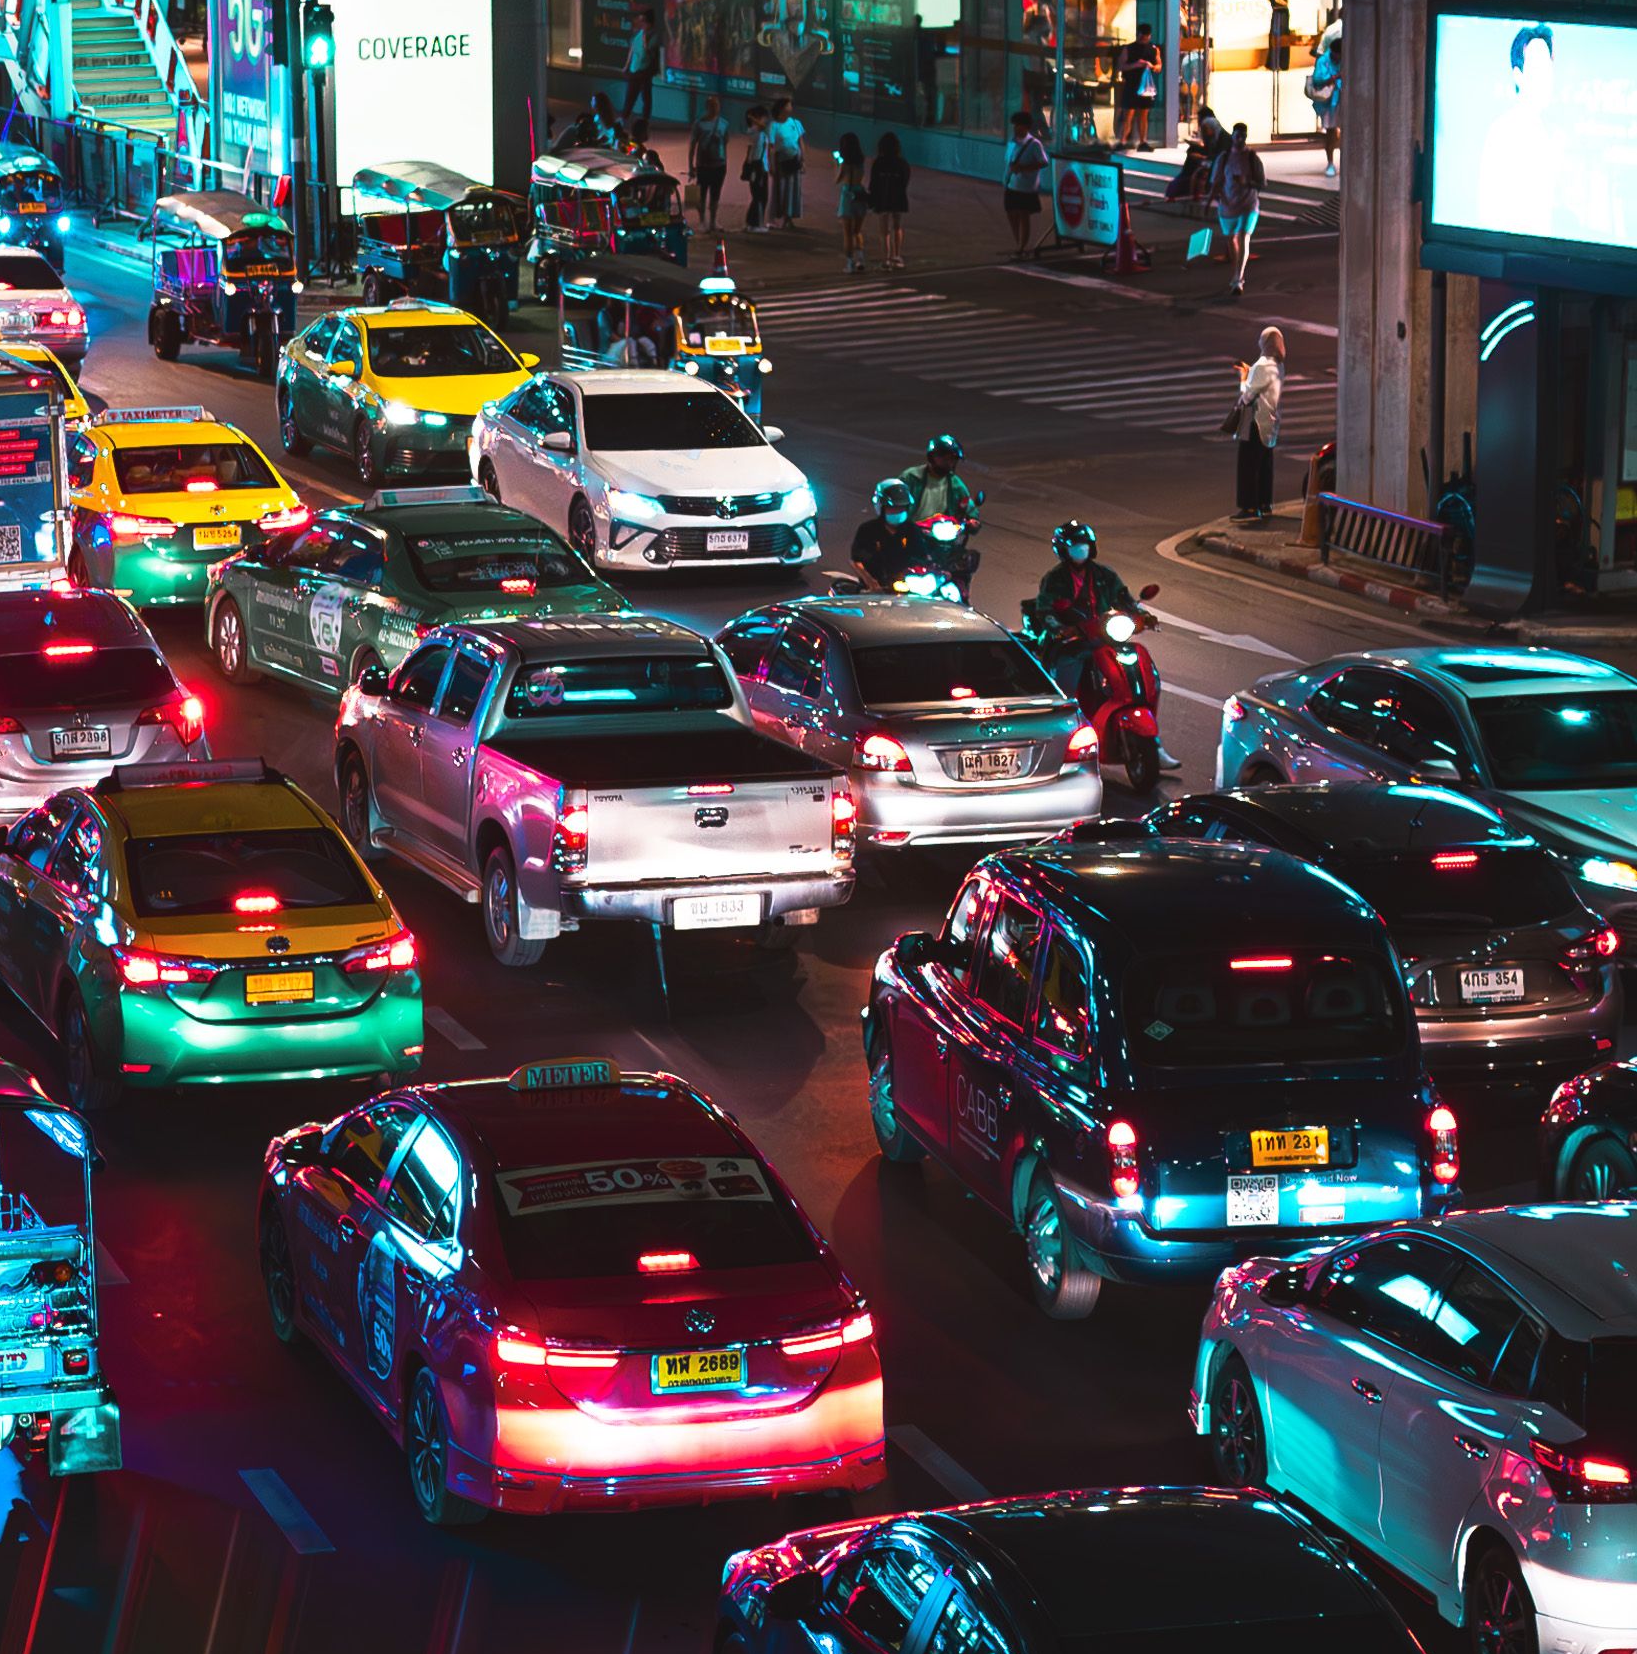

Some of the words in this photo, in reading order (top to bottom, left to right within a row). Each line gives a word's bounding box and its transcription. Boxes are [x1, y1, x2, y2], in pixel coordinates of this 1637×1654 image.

[358, 34, 471, 60] COVERAGE
[988, 754, 1016, 767] 1827
[714, 899, 745, 914] 1833
[1495, 971, 1518, 986] 354
[527, 1061, 610, 1087] METER
[957, 1074, 997, 1142] CABB
[1292, 1134, 1320, 1150] 231
[585, 1167, 669, 1193] 50%
[1336, 1173, 1358, 1183] Now
[698, 1354, 739, 1373] 2689
